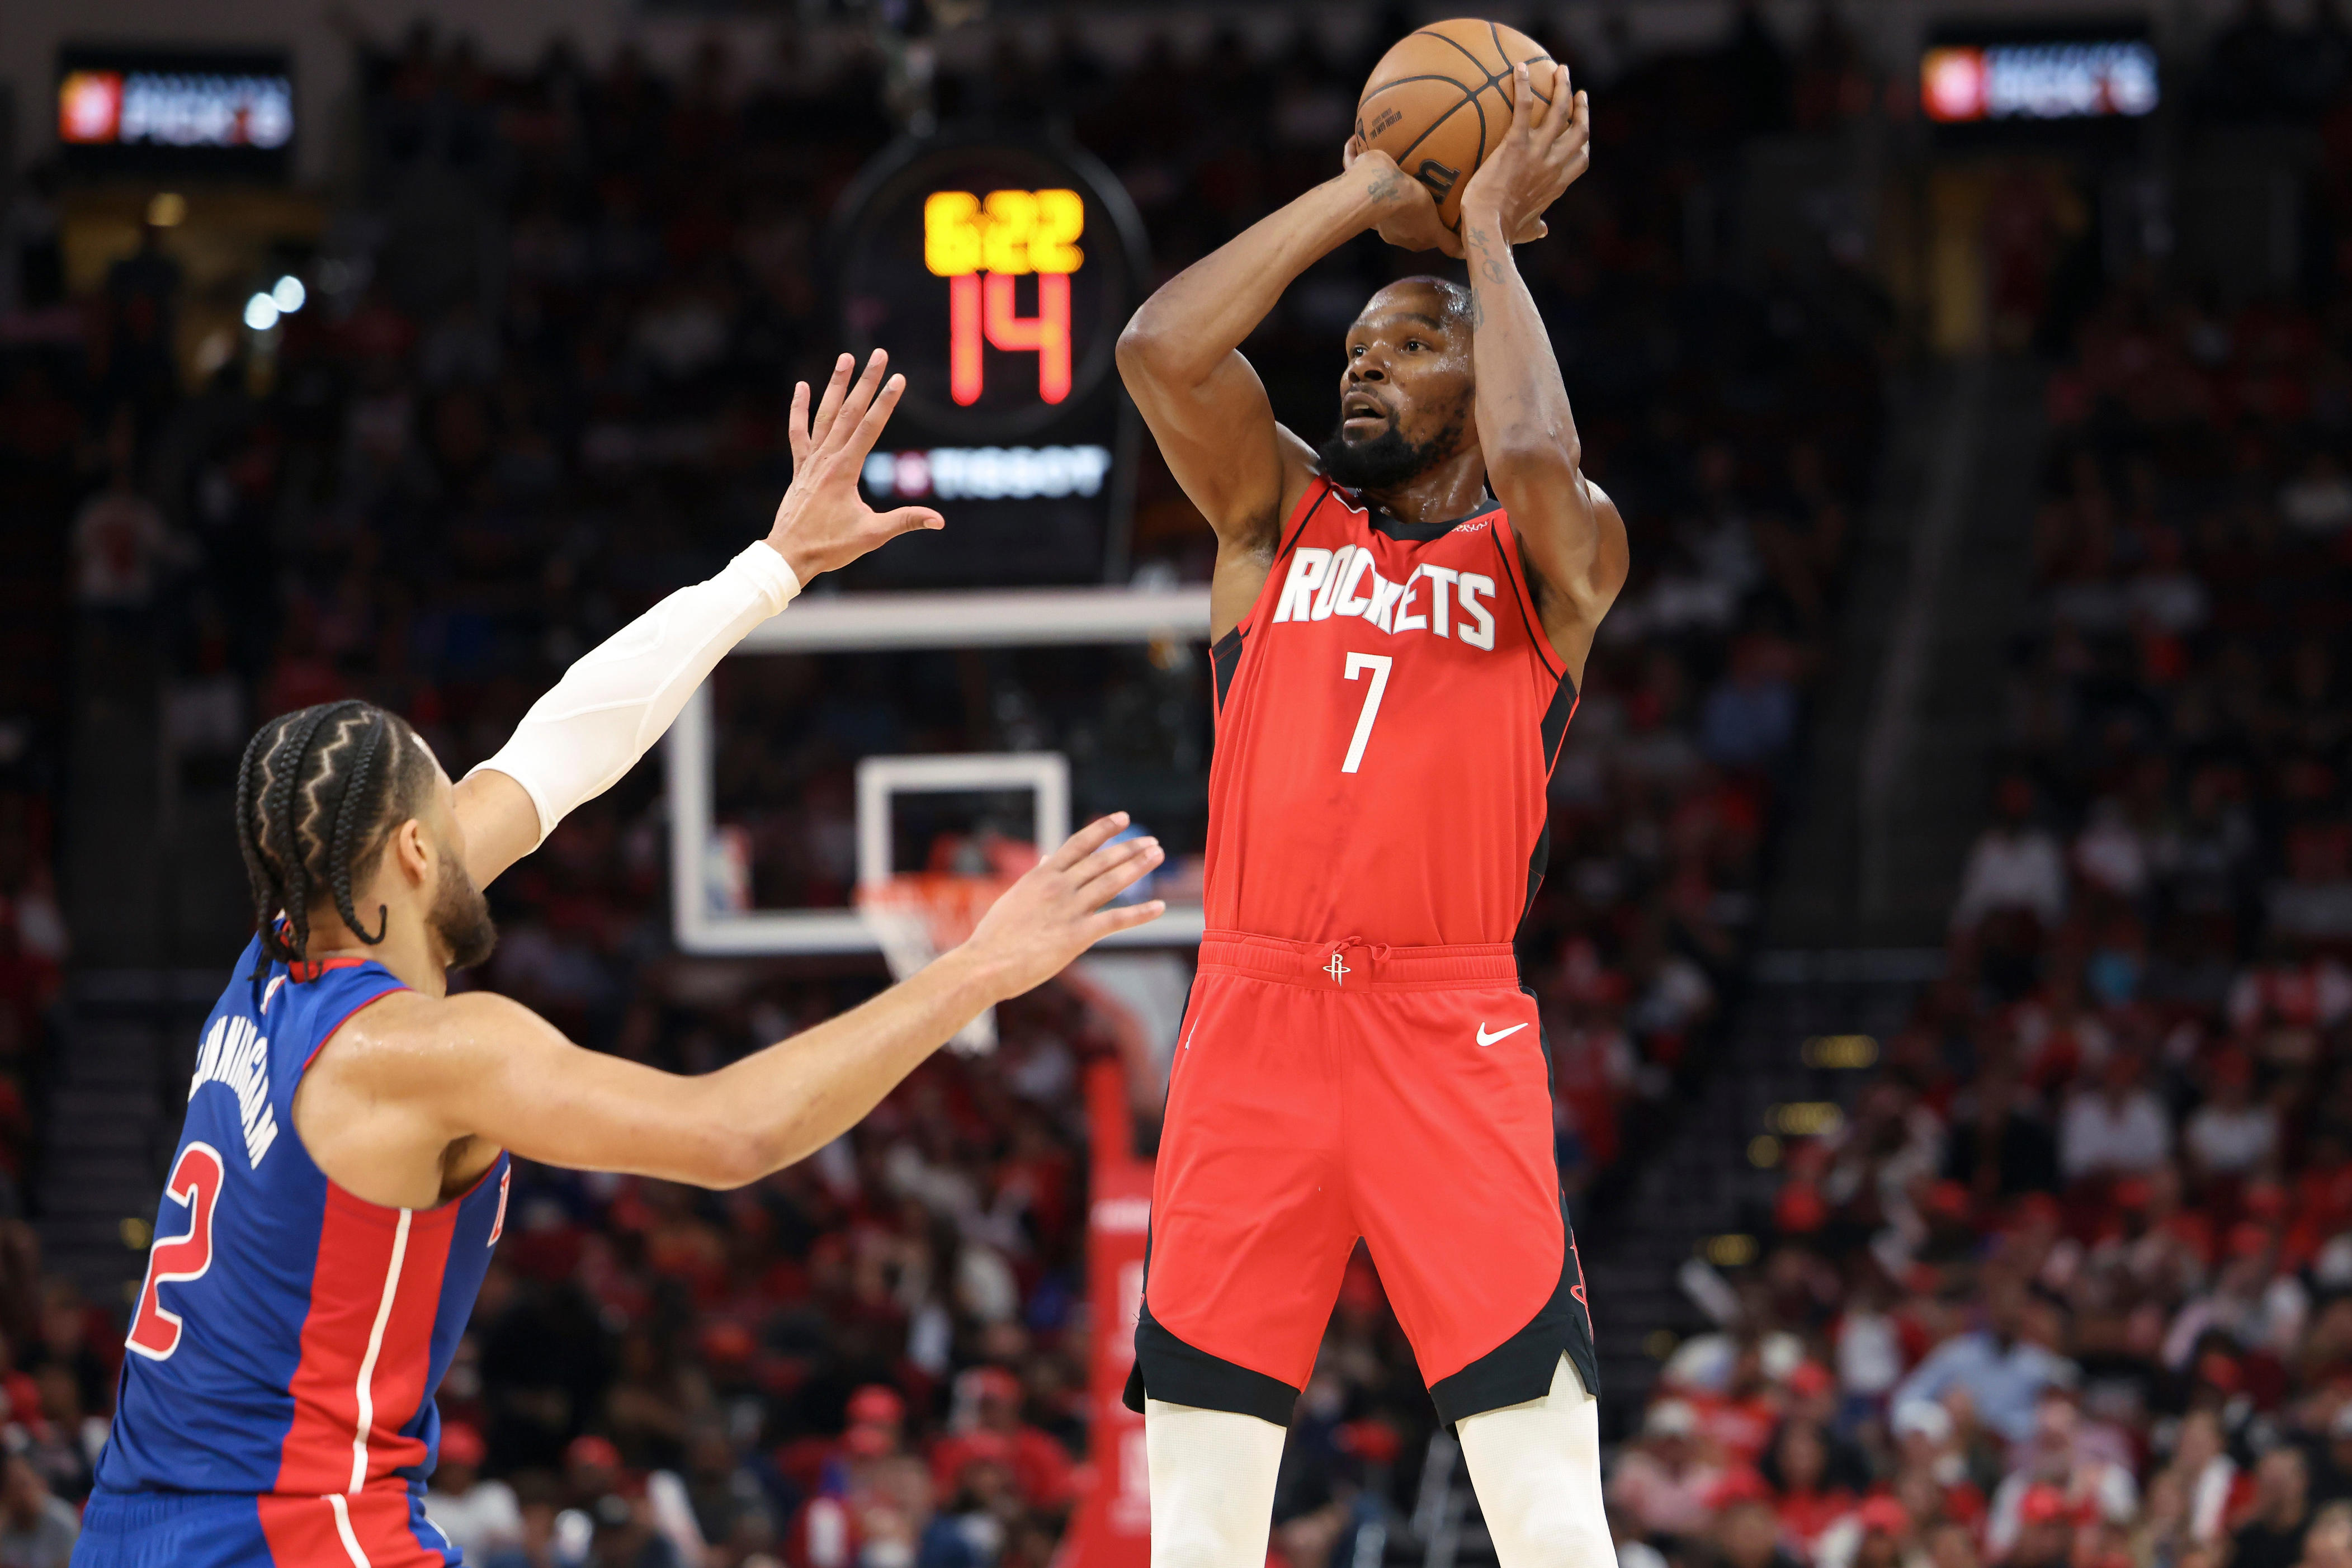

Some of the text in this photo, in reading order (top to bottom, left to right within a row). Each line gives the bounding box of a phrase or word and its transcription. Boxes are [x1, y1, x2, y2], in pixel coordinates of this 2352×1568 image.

[925, 189, 1084, 276] 6:22
[950, 271, 1072, 407] 14
[1272, 544, 1495, 651] ROCKETS
[1341, 651, 1392, 773] 7
[187, 1014, 278, 1170] UNNINGHAM
[125, 1141, 224, 1362] 2
